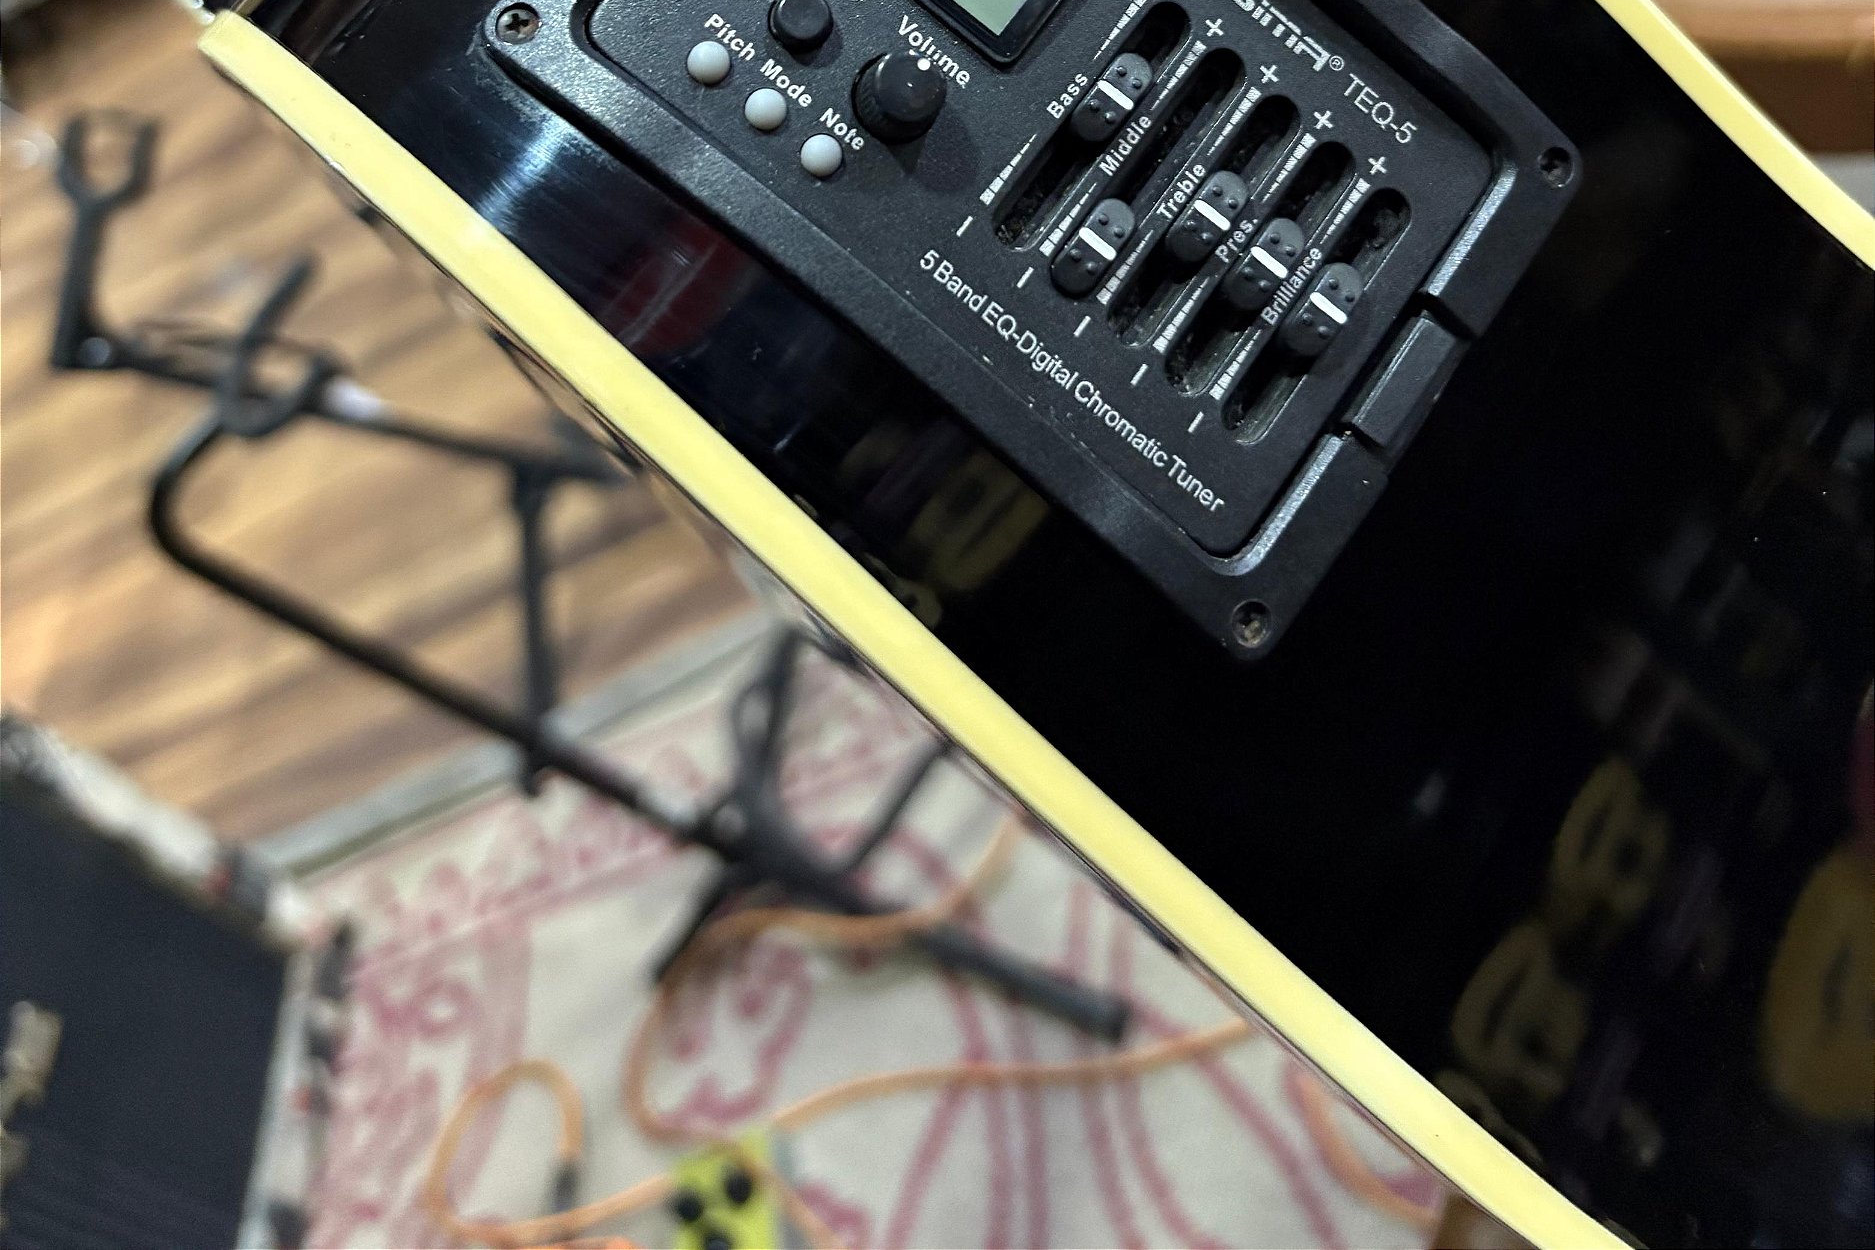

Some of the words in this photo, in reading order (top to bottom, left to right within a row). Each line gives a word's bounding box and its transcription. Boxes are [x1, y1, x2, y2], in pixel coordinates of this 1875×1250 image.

[704, 13, 756, 61] Pitch
[759, 58, 812, 108] Mode
[1046, 72, 1088, 119] Bass
[1343, 73, 1418, 144] TEQ-5
[819, 107, 865, 150] Note
[1099, 115, 1151, 177] Middle
[1156, 163, 1206, 220] Treble
[1214, 218, 1259, 264] Pres.
[1260, 248, 1323, 326] Brilliance
[919, 249, 940, 270] 5
[933, 259, 988, 312] Band
[980, 301, 1080, 390] EQ-Digital
[1073, 380, 1169, 468] Chromatic
[1167, 454, 1225, 512] Tuner
